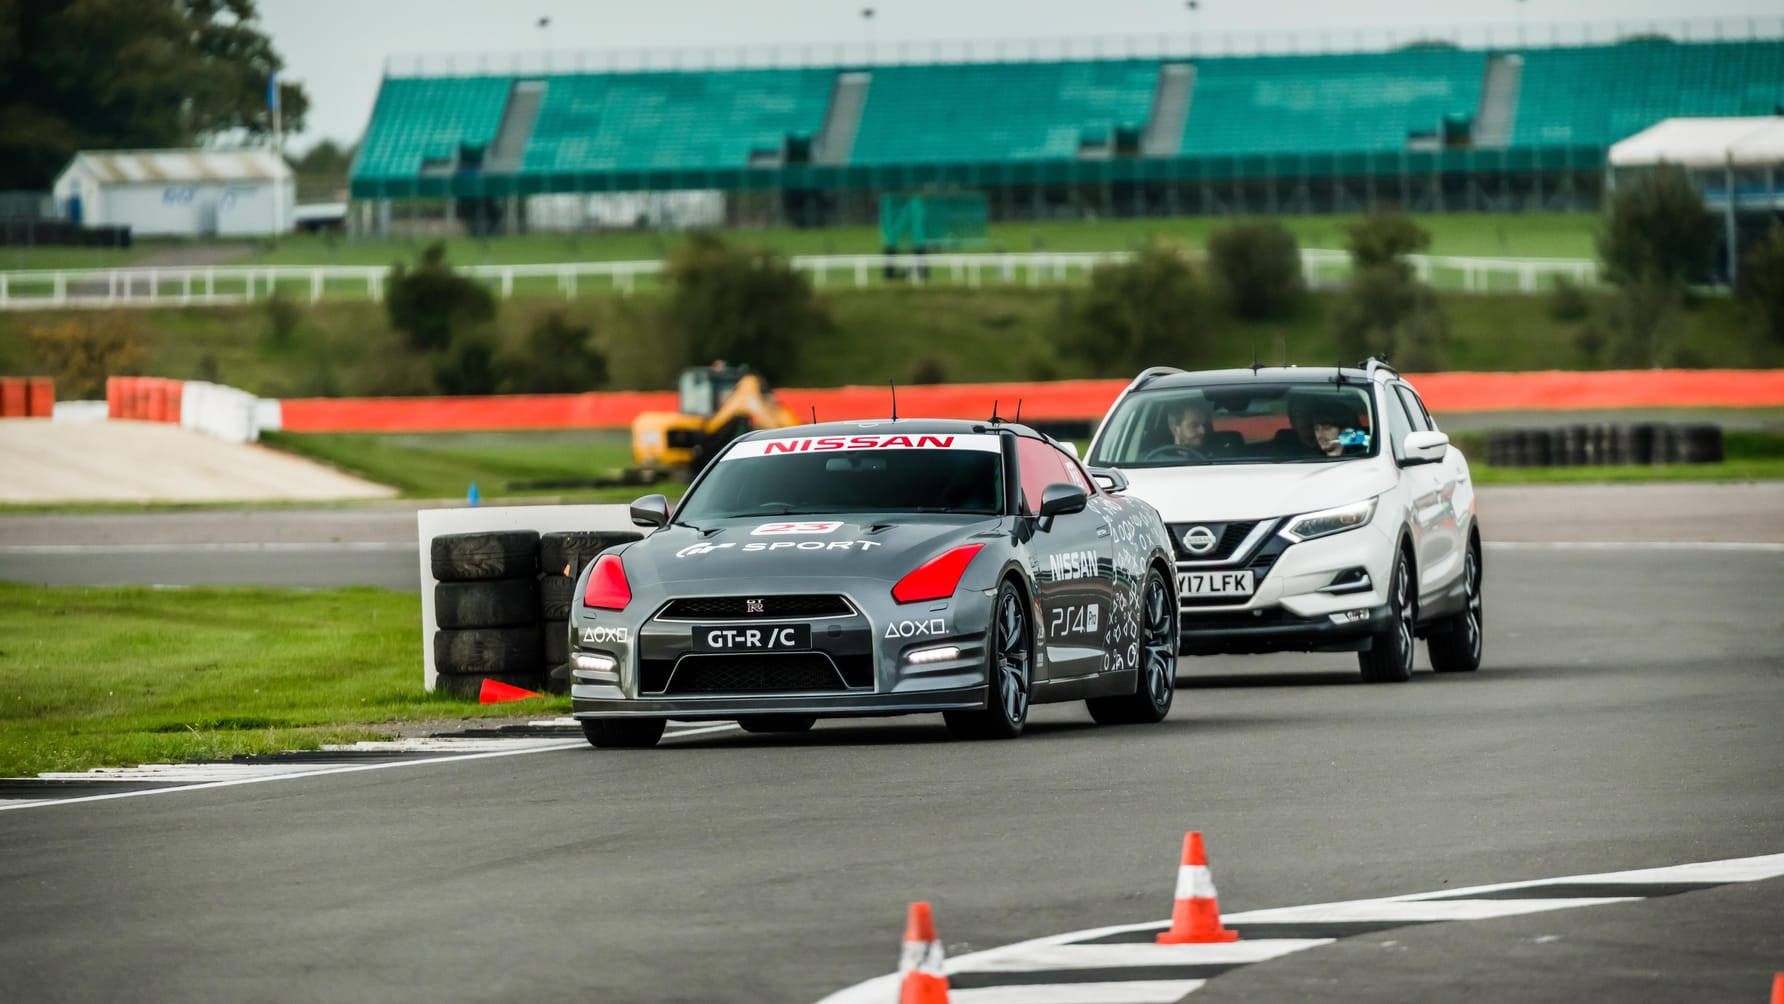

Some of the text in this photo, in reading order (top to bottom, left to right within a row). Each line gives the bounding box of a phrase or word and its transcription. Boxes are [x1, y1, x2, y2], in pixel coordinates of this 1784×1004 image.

[764, 436, 955, 455] NISSAN
[760, 522, 834, 532] 23
[742, 540, 881, 551] SPORT
[1049, 550, 1099, 581] NISSAN
[1210, 574, 1246, 592] LFK
[1051, 605, 1085, 637] PS4
[707, 628, 795, 648] GT-R /C
